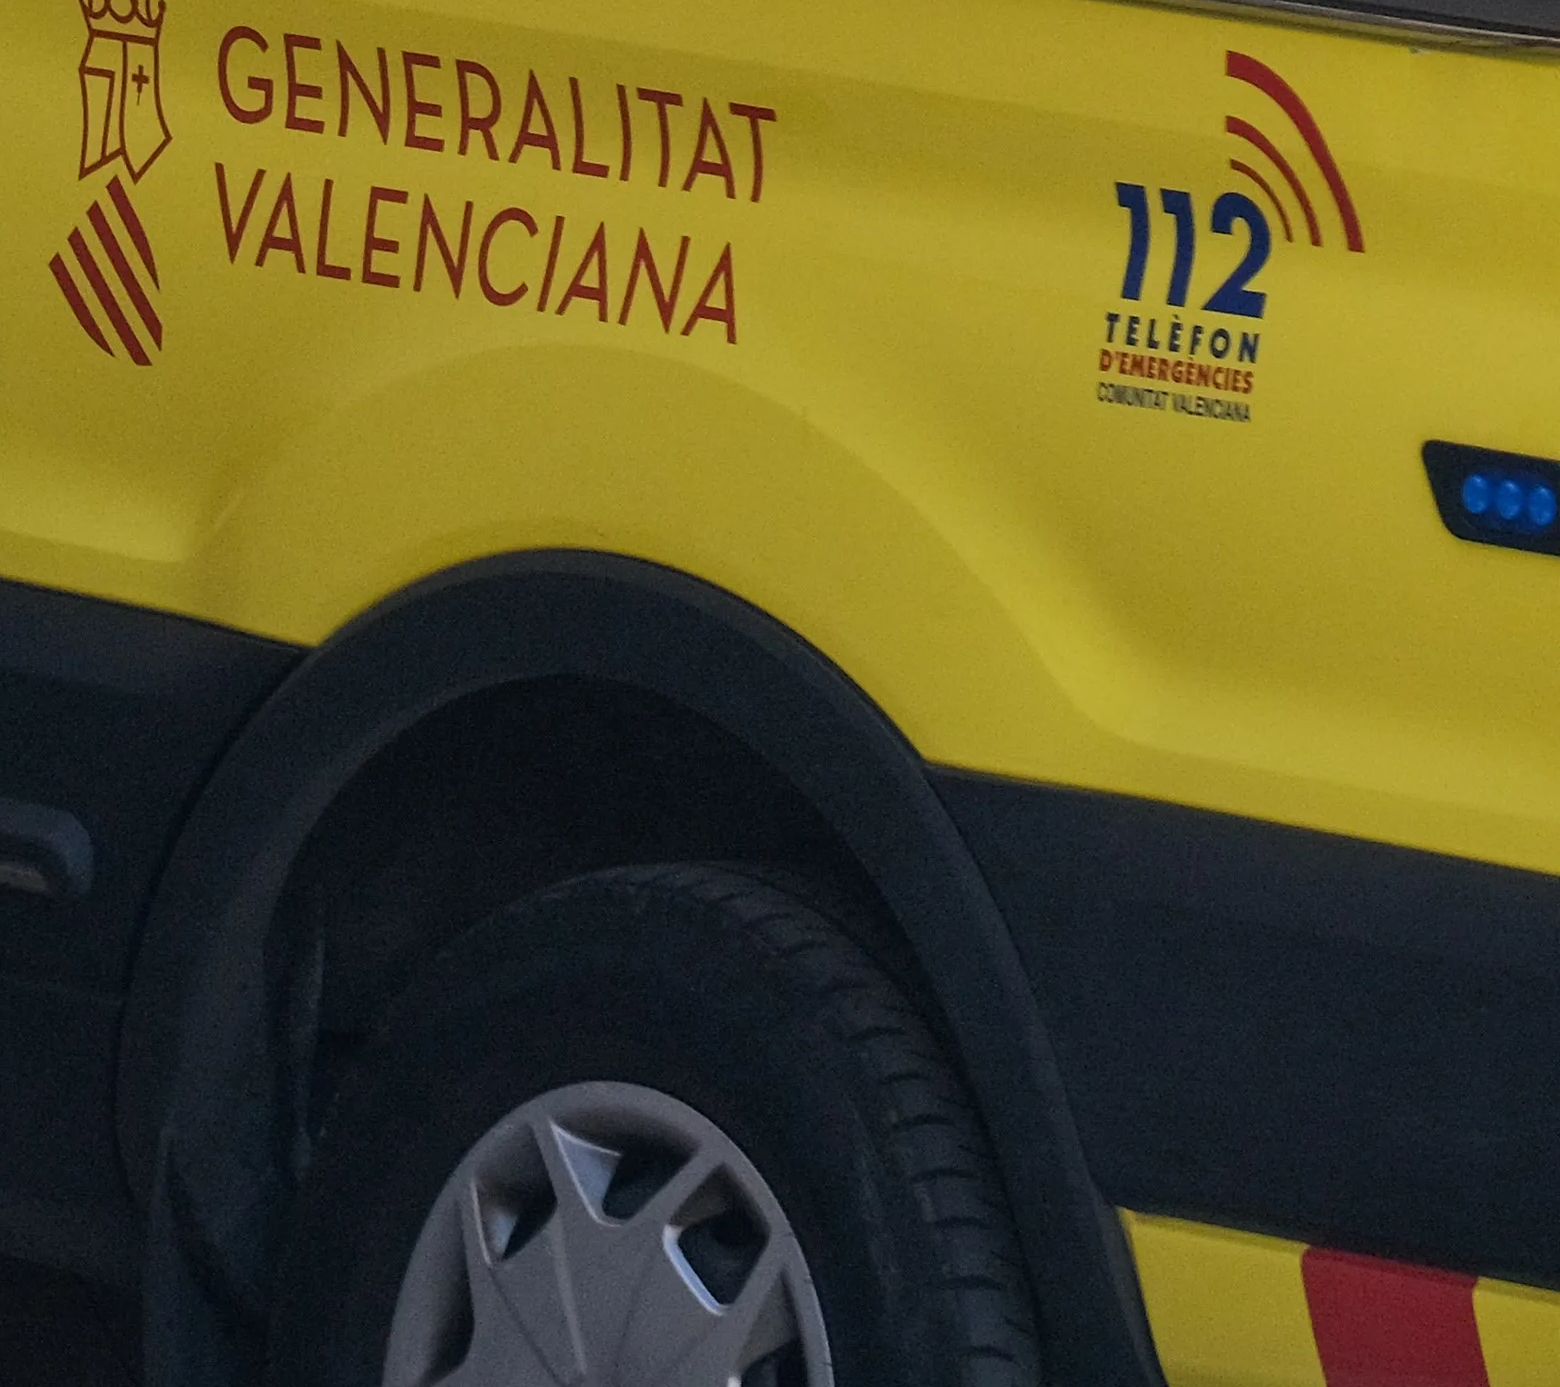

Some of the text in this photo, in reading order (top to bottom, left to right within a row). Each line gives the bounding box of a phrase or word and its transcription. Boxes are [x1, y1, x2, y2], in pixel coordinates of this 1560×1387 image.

[218, 26, 777, 203] GENERALITAT
[214, 162, 737, 345] VALENCIANA
[1115, 181, 1272, 319] 112
[1106, 312, 1260, 363] TELÈFON
